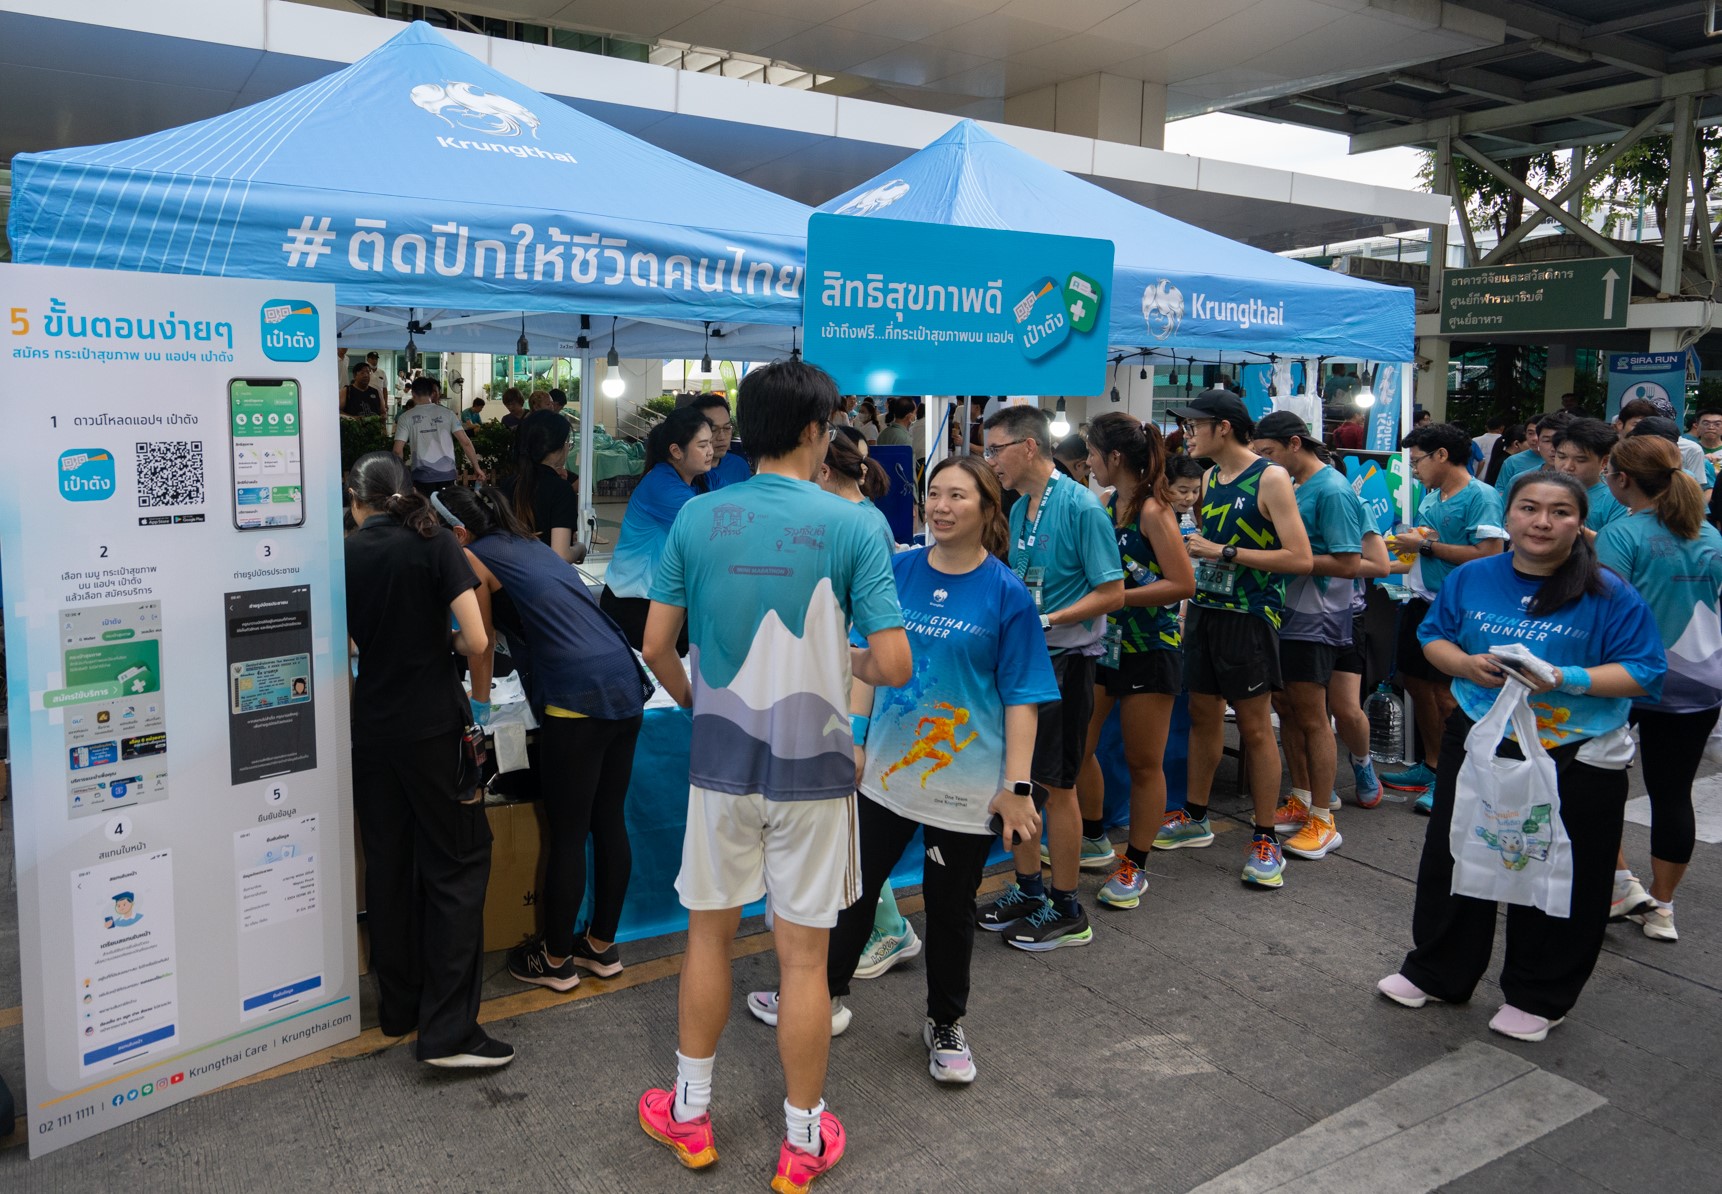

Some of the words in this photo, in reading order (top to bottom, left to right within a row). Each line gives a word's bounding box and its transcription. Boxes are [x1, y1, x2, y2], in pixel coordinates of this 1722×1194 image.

[435, 135, 578, 165] Krungthai
[821, 270, 1003, 322] สิทธิสุขภาพดี
[1191, 291, 1285, 330] Krungthai
[10, 307, 30, 336] 5
[43, 297, 234, 349] ขั้นตอนง่ายๆ
[1449, 312, 1503, 330] ศูนย์อาหาร
[265, 329, 315, 349] เป๋าตัง
[986, 330, 1014, 344] แอปฯ
[1022, 311, 1065, 350] เป๋าตัง
[12, 346, 50, 360] สมัคร
[54, 348, 140, 364] กระเป๋าสุขภาพ
[144, 351, 161, 362] บน
[165, 351, 197, 363] แอปฯ
[200, 350, 234, 364] เป๋าตัง
[1630, 357, 1653, 365] SIRA
[1655, 355, 1678, 364] RUN
[50, 415, 57, 428] 1
[73, 413, 163, 428] ดาวน์โหลดแอปฯ
[166, 413, 199, 427] เป๋าตัง
[63, 475, 111, 492] เป๋าตัง
[100, 546, 108, 558] 2
[264, 546, 271, 558] 3
[61, 570, 82, 582] เลือก
[85, 571, 101, 582] เมนู
[102, 564, 157, 579] กระเป๋าสุขภาพ
[233, 566, 300, 580] ถ่ายรูปบัตรประชาชน
[78, 581, 91, 590] บน
[118, 576, 142, 588] เป๋าตัง
[65, 590, 102, 603] แล้วเลือก
[104, 587, 153, 599] สมัครบริการ
[898, 604, 971, 632] RUNGTHAI
[1474, 610, 1572, 635] KRUNGTHAI
[903, 620, 951, 639] UNNER
[1480, 622, 1548, 642] RUNNER
[273, 788, 281, 800] 5
[114, 823, 123, 836] 4
[281, 1013, 352, 1044] Krungthai.com
[189, 1051, 242, 1078] Krungthai
[245, 1044, 268, 1058] Care
[39, 1120, 54, 1134] 02
[57, 1114, 72, 1127] 111
[76, 1105, 95, 1120] 1111
